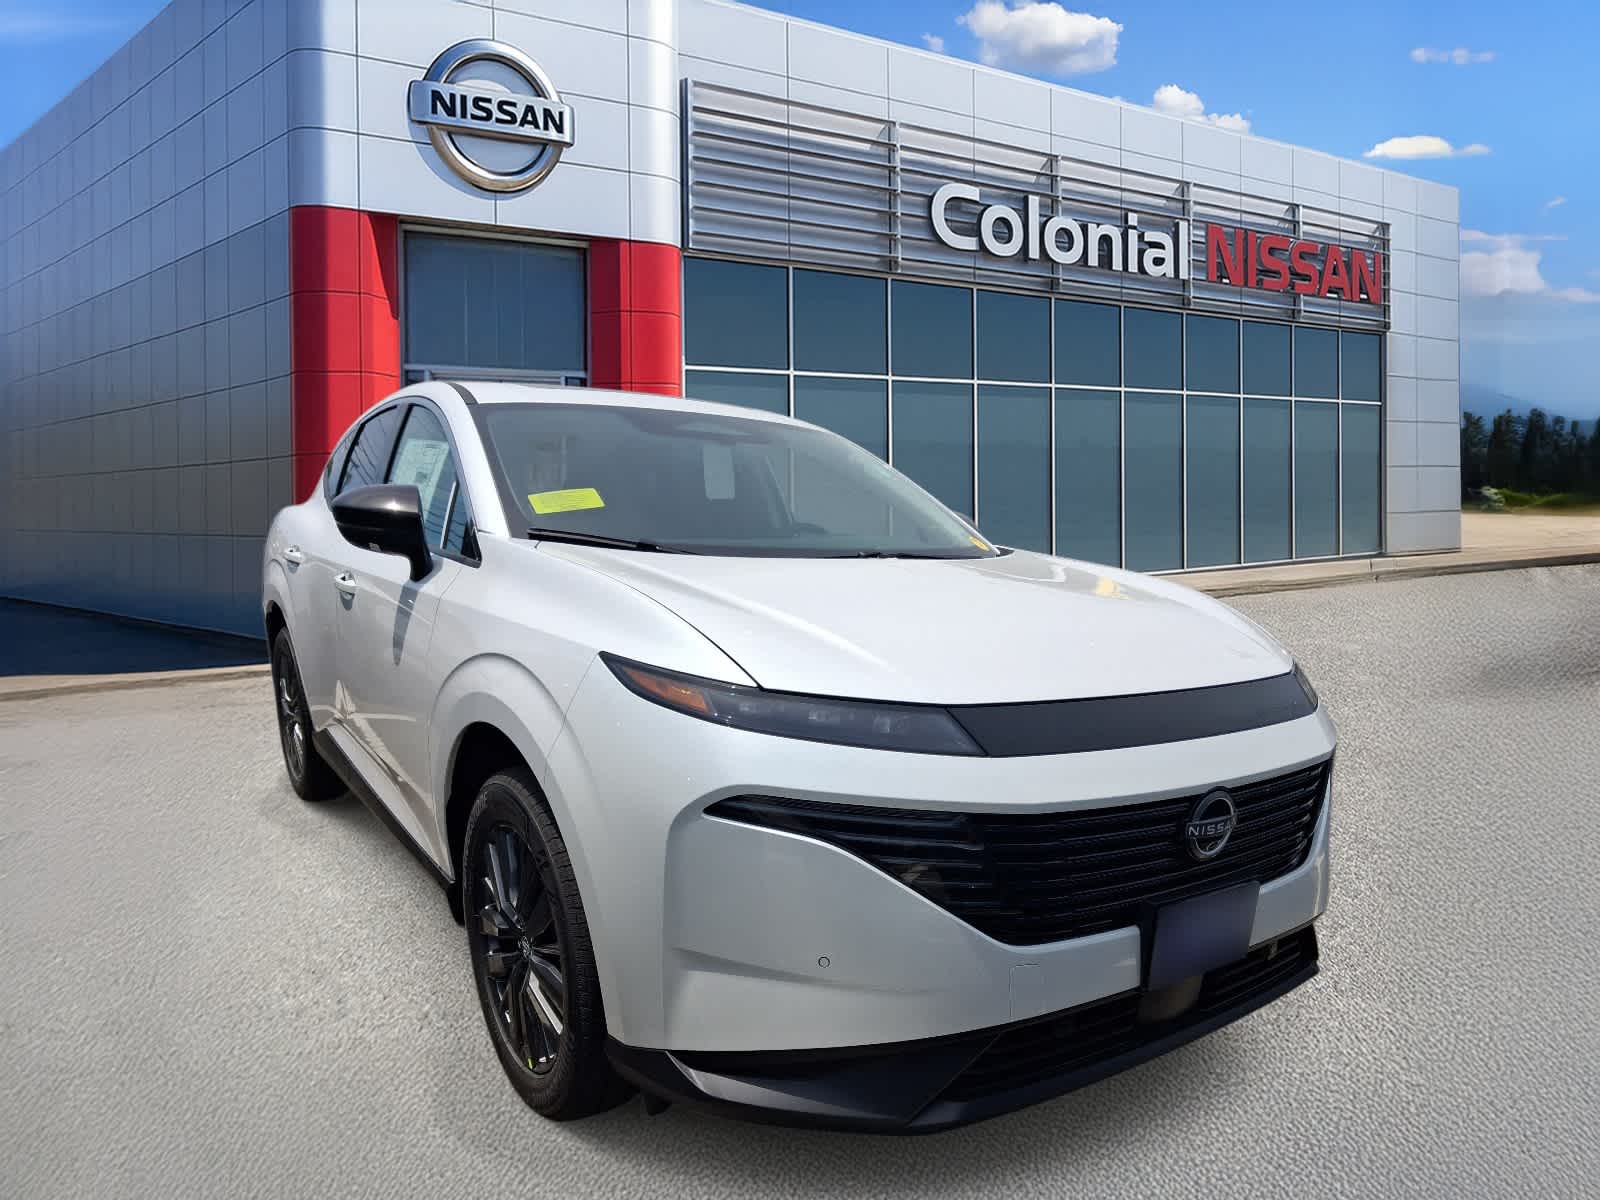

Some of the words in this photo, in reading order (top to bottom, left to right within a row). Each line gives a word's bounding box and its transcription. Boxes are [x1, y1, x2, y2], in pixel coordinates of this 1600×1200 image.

[430, 90, 564, 134] NISSAN
[930, 183, 1190, 280] Colonial
[1206, 224, 1382, 304] NISSAN
